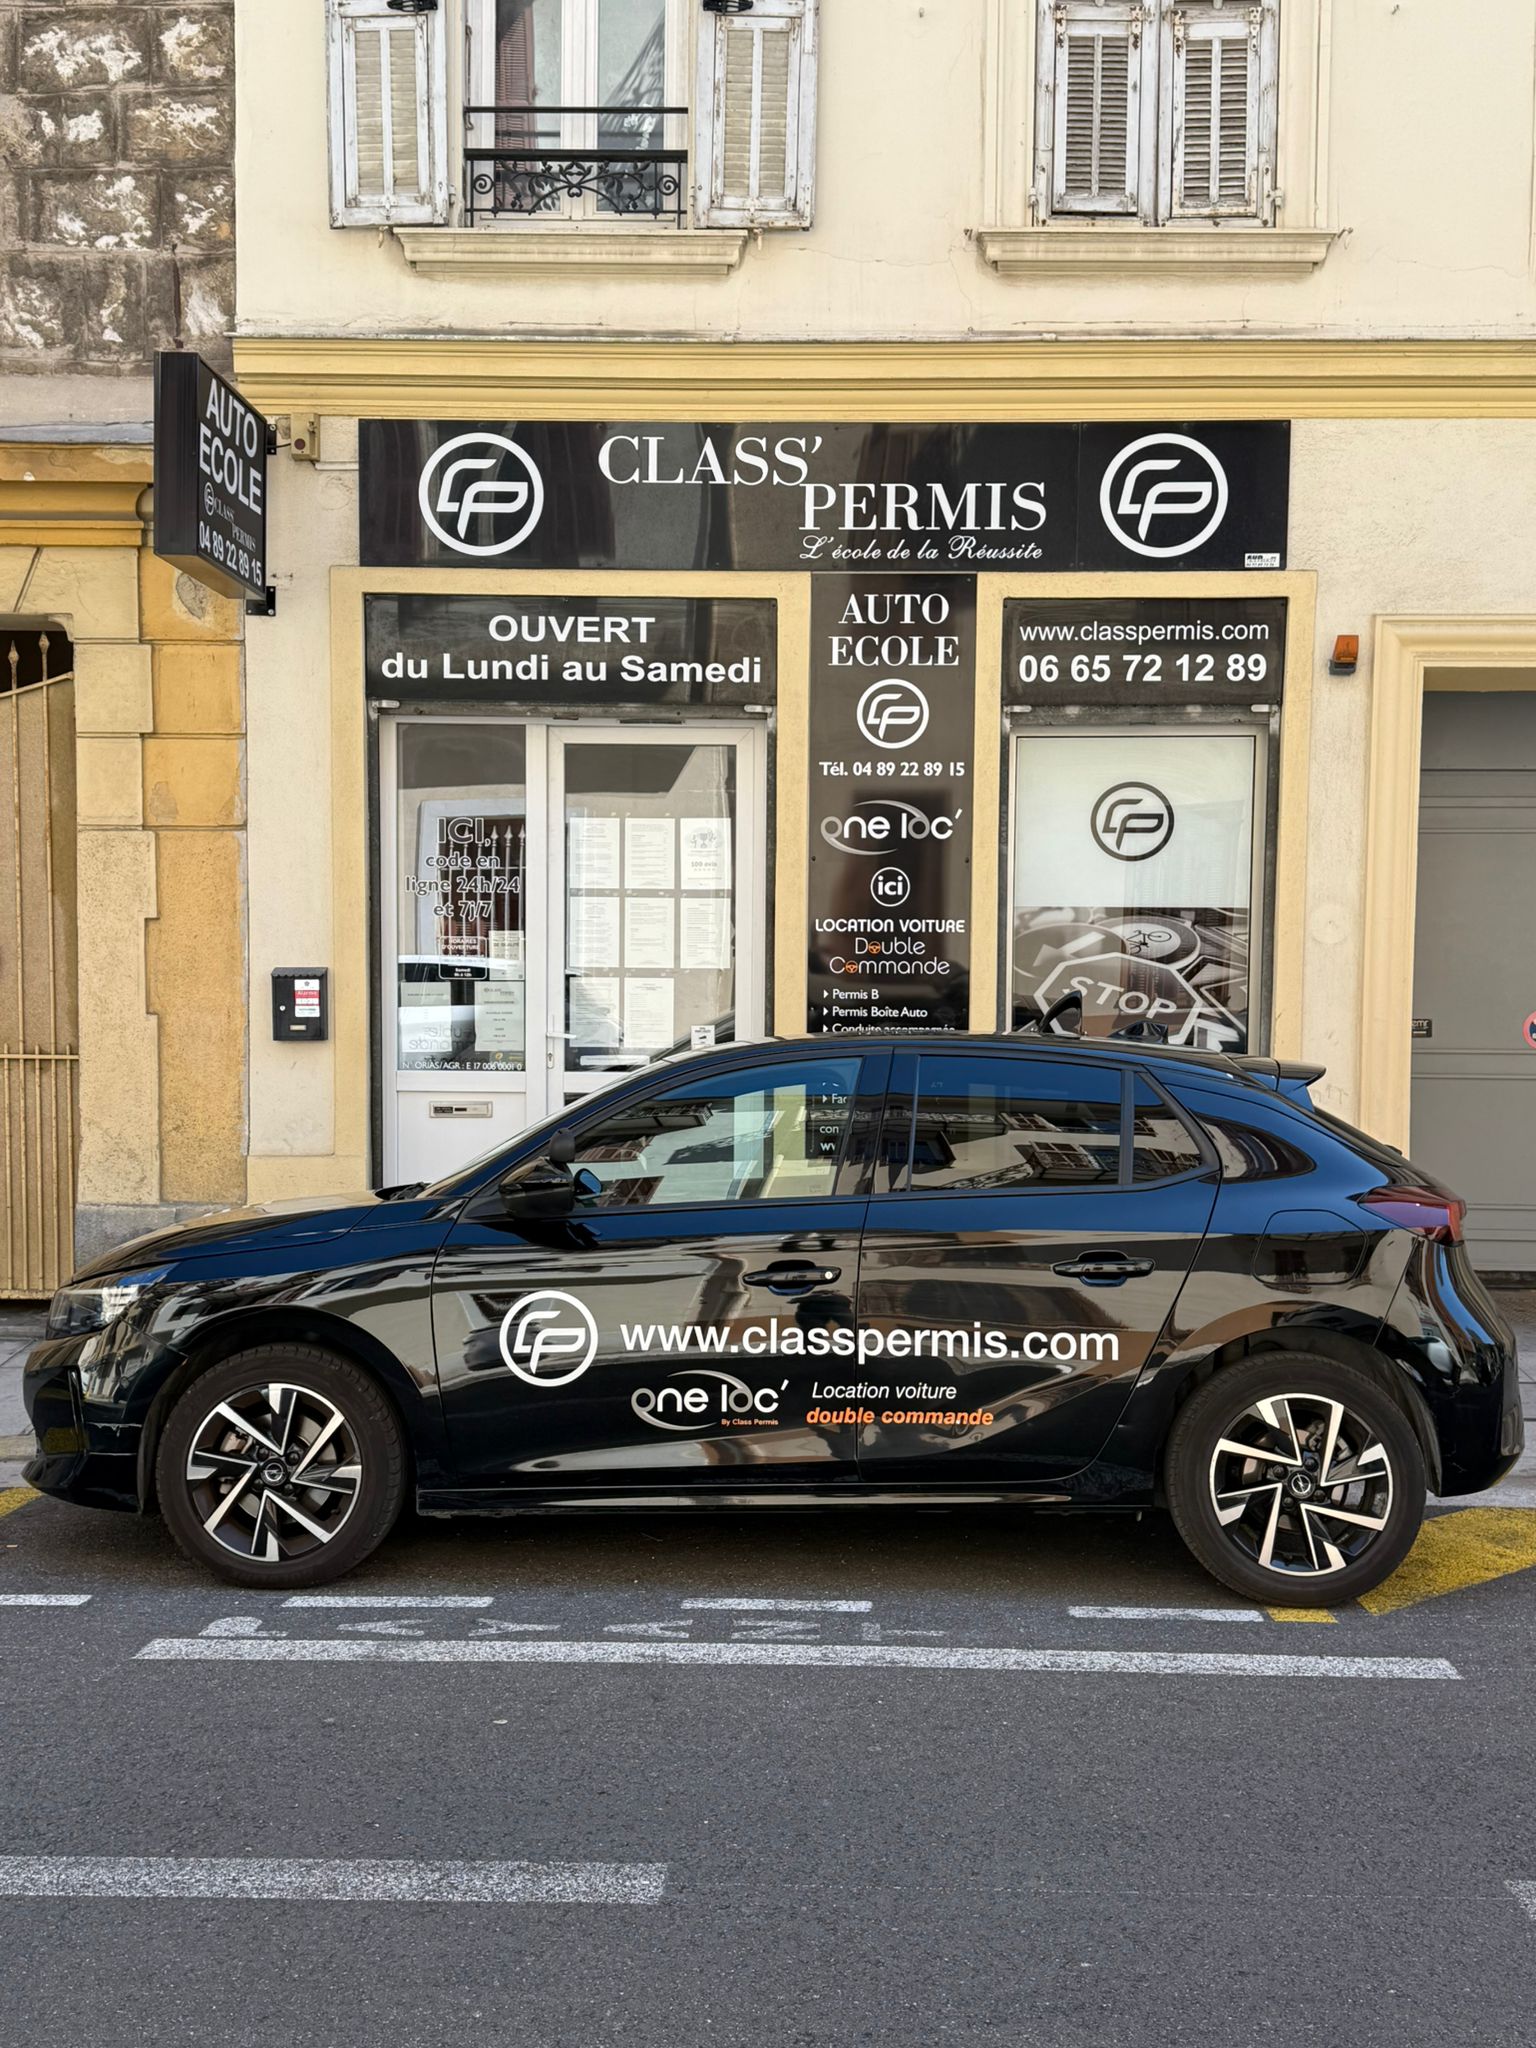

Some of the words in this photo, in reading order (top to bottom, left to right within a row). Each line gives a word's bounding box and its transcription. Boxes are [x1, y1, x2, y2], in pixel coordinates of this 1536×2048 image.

[206, 378, 258, 458] AUTO
[199, 422, 262, 515] ECOLE
[598, 435, 824, 486] CLASS'
[799, 482, 1046, 531] PERMIS
[199, 521, 211, 552] 04
[212, 530, 224, 562] 89
[225, 539, 237, 573] 22
[251, 558, 262, 586] 15
[800, 535, 881, 559] L'école
[887, 539, 910, 559] de
[918, 539, 938, 559] la
[948, 535, 1042, 559] Réussite
[838, 594, 949, 624] AUTO
[489, 615, 655, 642] OUVERT
[1020, 621, 1268, 645] www.classpermis.com
[828, 636, 959, 666] ECOLE
[382, 652, 427, 678] du
[443, 653, 548, 680] Lundi
[563, 662, 606, 681] au
[621, 655, 760, 682] Samedi
[1020, 655, 1058, 682] 06
[1071, 655, 1110, 682] 65
[1123, 655, 1162, 681] 72
[1176, 654, 1214, 681] 12
[1227, 654, 1266, 681] 89
[819, 762, 848, 775] Tél.
[853, 762, 872, 776] 04
[877, 762, 895, 776] 89
[901, 762, 919, 776] 22
[924, 762, 942, 776] 89
[950, 762, 964, 776] 15
[437, 816, 491, 847] ICI,
[820, 815, 891, 840] one
[425, 850, 471, 868] code
[475, 855, 501, 869] en
[405, 875, 451, 896] ligne
[455, 875, 520, 894] 24h/24
[877, 875, 903, 896] ici
[432, 901, 454, 917] et
[457, 900, 493, 922] 7j/7
[816, 919, 893, 932] LOCATION
[899, 919, 965, 933] VOITURE
[833, 989, 868, 999] Permis
[872, 989, 879, 999] B
[1062, 976, 1177, 1018] STOP
[833, 1006, 868, 1016] Permis
[871, 1006, 899, 1017] Boîte
[900, 1007, 927, 1017] Auto
[620, 1318, 1118, 1364] www.classpermis.com
[631, 1387, 709, 1413] one
[811, 1382, 890, 1399] Location
[895, 1382, 958, 1400] voiture
[732, 1418, 752, 1426] Class
[753, 1418, 779, 1426] Permis
[806, 1407, 875, 1424] double
[881, 1408, 994, 1425] commande
